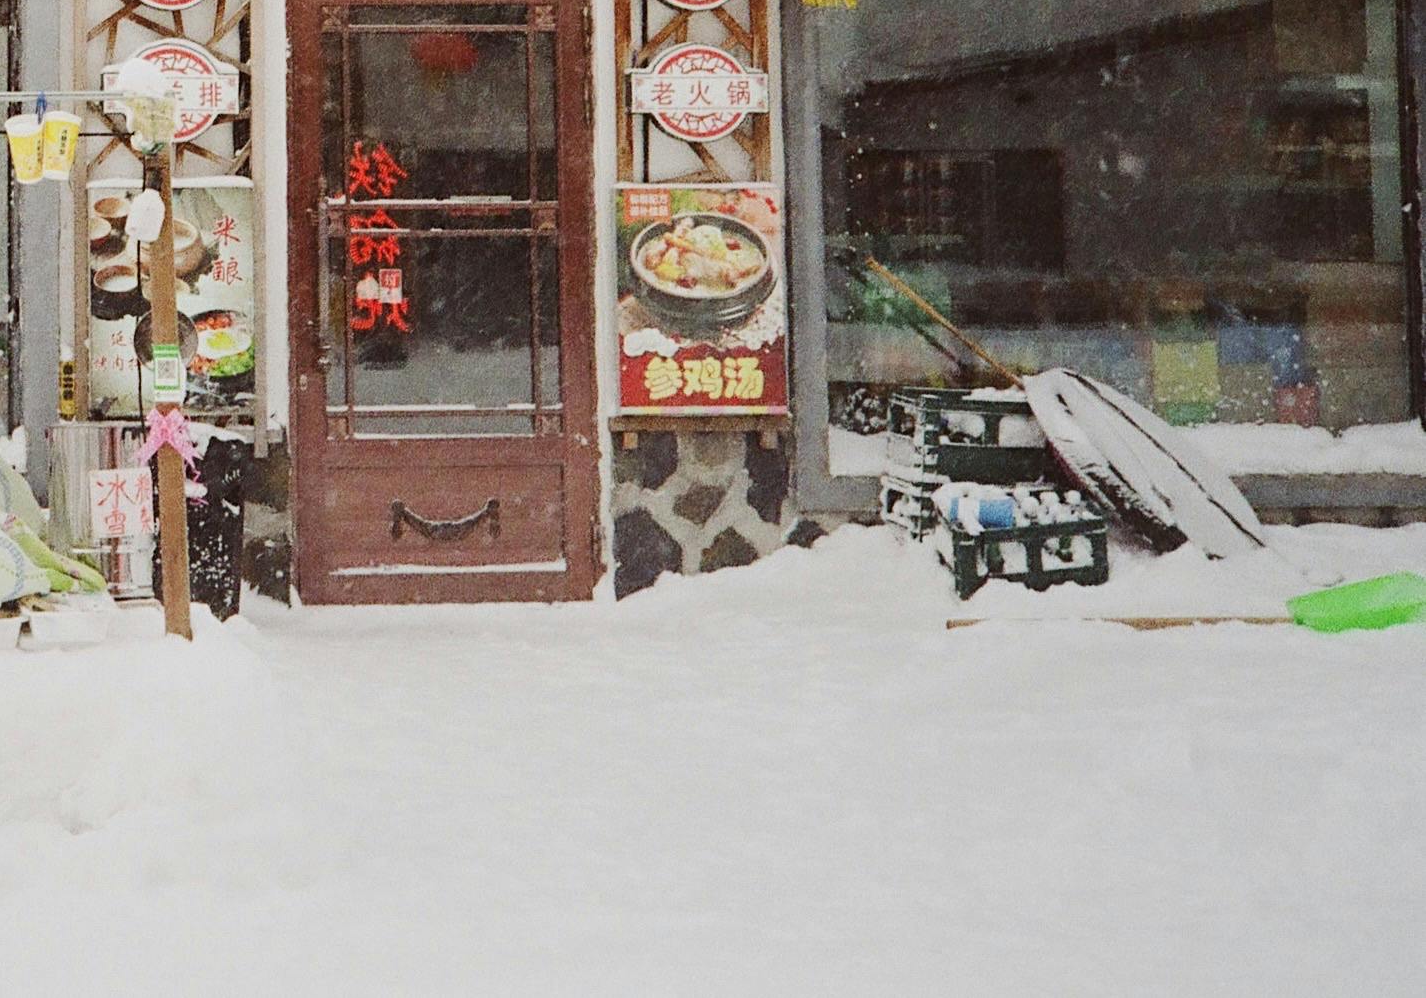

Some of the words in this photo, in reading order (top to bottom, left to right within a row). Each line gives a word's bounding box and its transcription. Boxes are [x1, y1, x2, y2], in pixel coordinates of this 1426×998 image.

[651, 81, 751, 106] 老火锅
[644, 356, 765, 400] 参鸡汤
